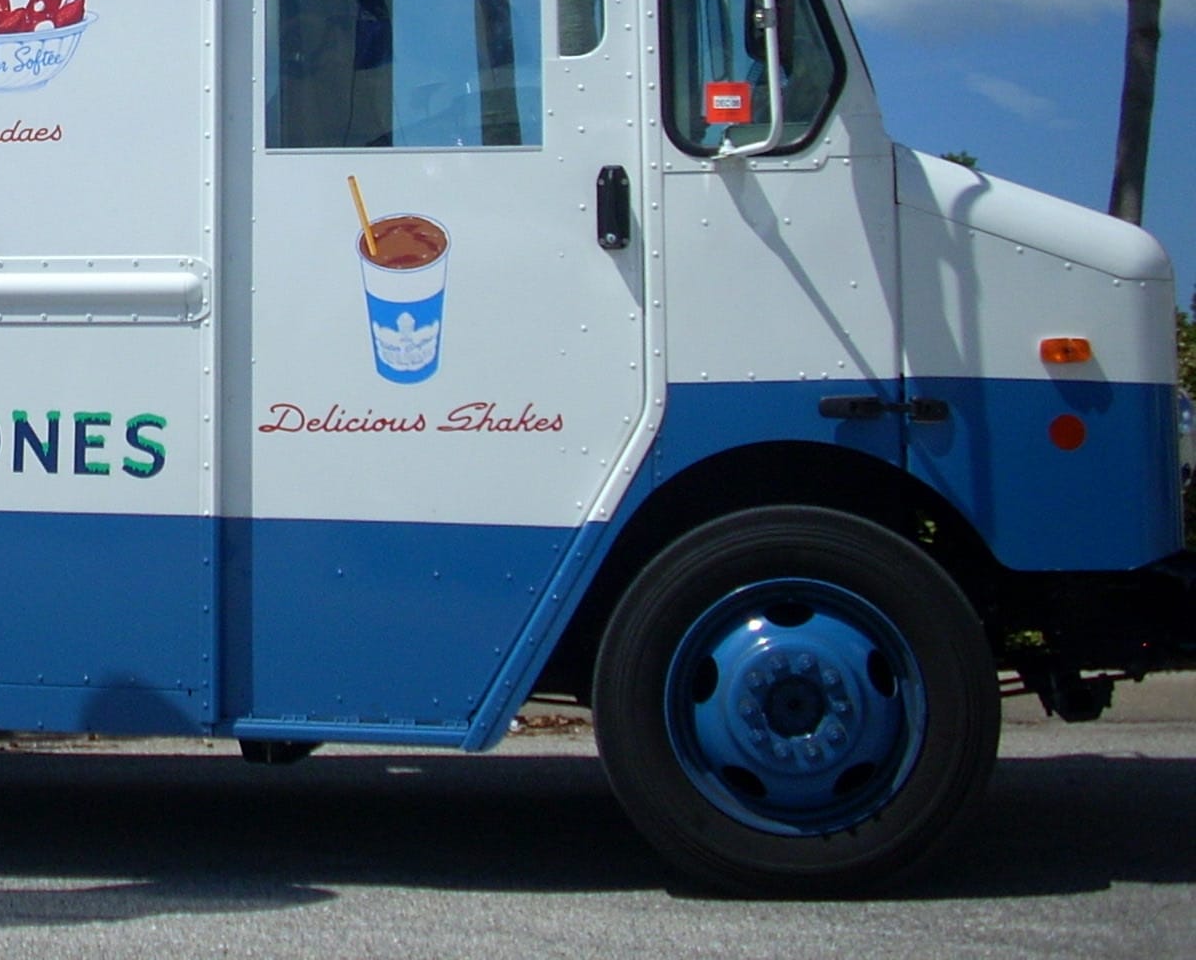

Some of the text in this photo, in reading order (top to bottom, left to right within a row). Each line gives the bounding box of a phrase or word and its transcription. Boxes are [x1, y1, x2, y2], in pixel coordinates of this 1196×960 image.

[13, 46, 64, 75] Softee
[258, 402, 564, 433] Delicious Shakes
